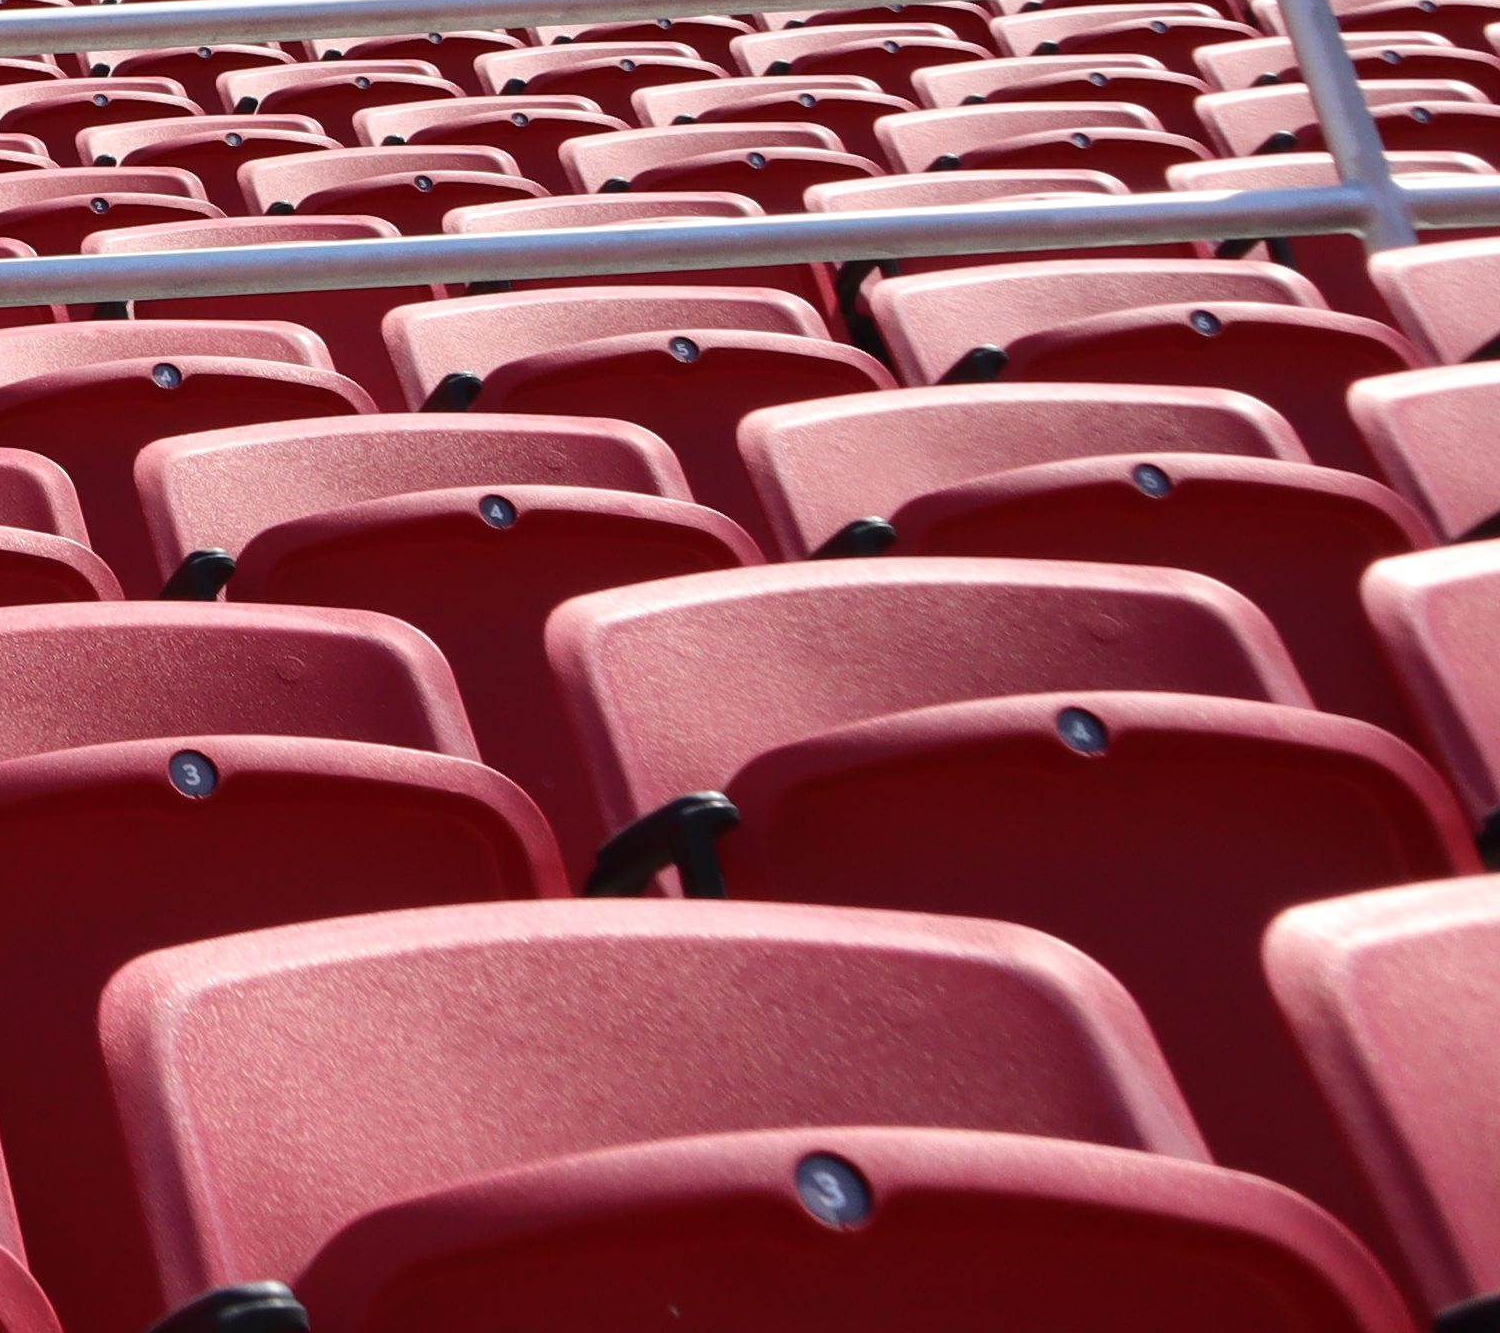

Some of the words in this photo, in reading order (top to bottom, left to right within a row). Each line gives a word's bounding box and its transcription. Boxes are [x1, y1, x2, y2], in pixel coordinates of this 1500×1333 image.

[676, 343, 689, 357] 5
[160, 369, 172, 382] 4
[490, 503, 504, 520] 4
[1071, 720, 1092, 743] 4
[182, 763, 201, 786] 3
[812, 1170, 848, 1208] 3
